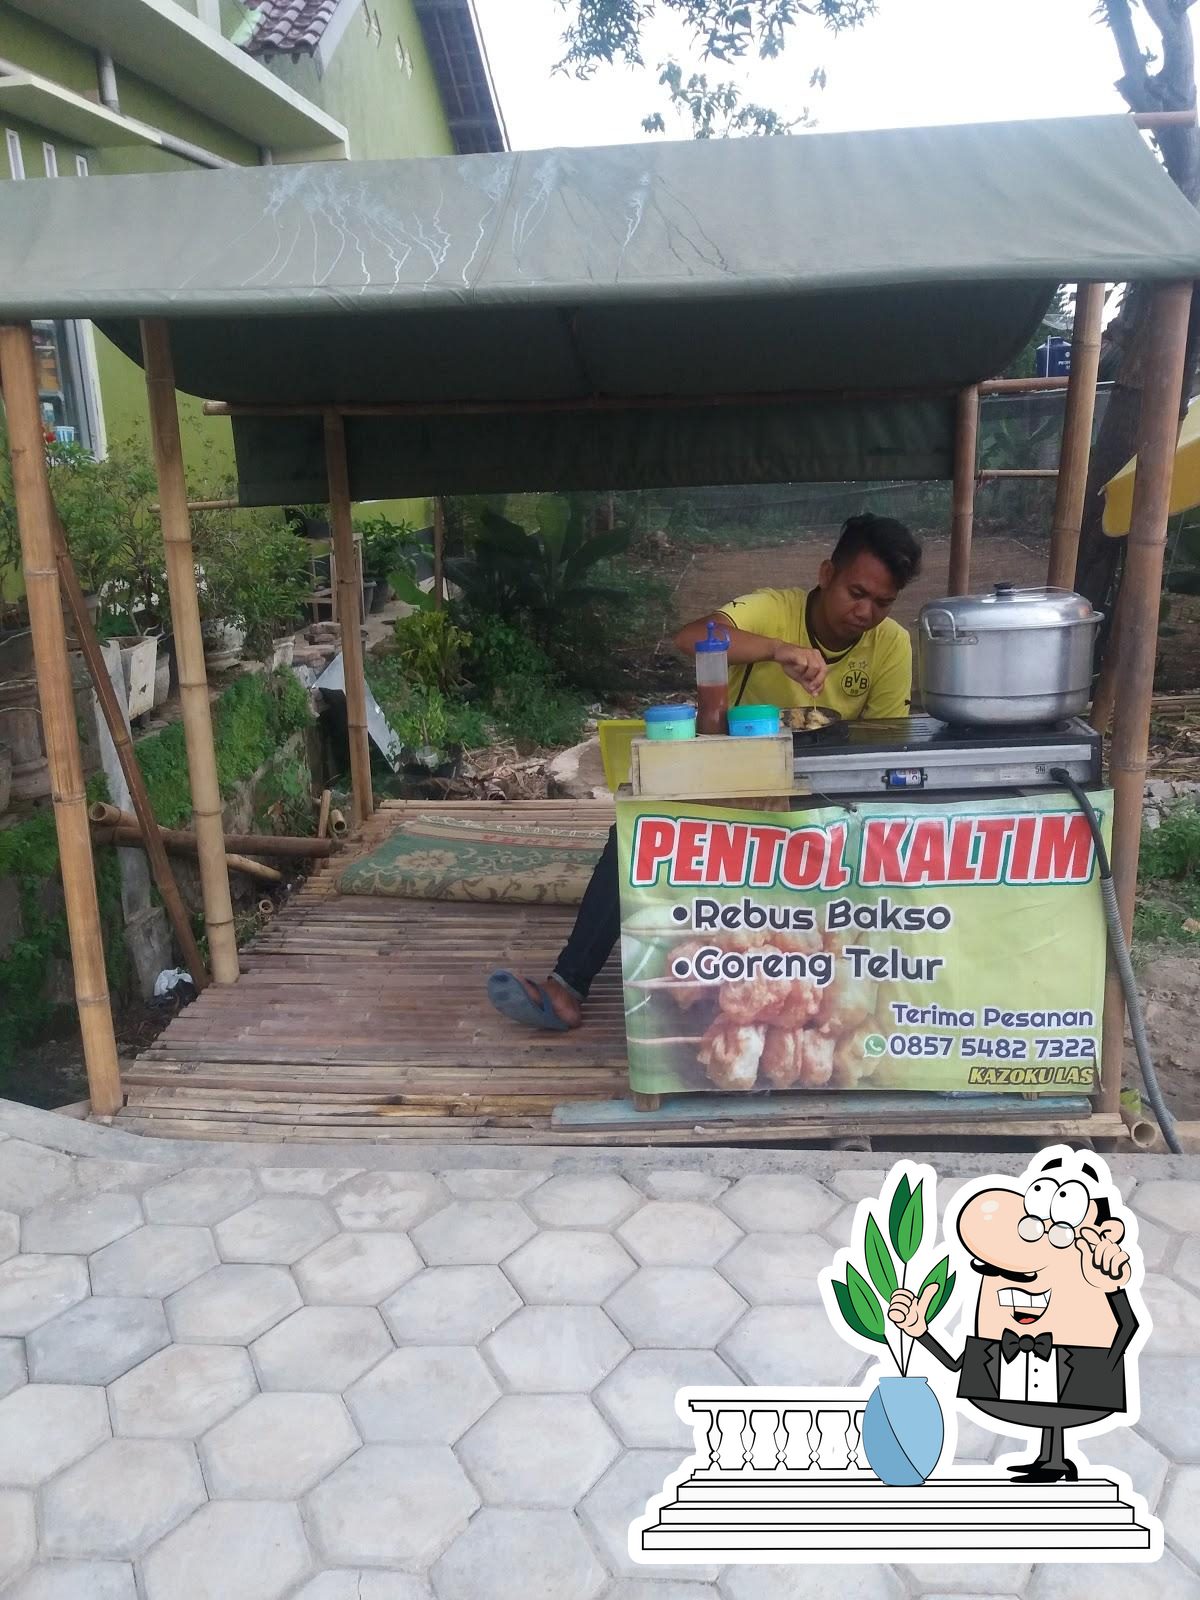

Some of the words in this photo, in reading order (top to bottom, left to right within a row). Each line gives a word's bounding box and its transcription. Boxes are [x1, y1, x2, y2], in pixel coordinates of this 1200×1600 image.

[845, 671, 868, 689] BVB
[632, 814, 851, 890] PENTOL
[859, 811, 1097, 885] KALTIM
[694, 899, 814, 930] Rebus
[827, 899, 951, 931] Bakso
[694, 948, 832, 985] Goreng
[845, 948, 943, 981] Telur
[892, 1003, 975, 1027] Terima
[983, 1007, 1094, 1028] Pesanan
[889, 1035, 953, 1056] 0857
[960, 1037, 1027, 1059] 5482
[1034, 1037, 1095, 1059] 7322
[968, 1066, 1054, 1085] KAZOKU
[1054, 1066, 1095, 1085] LAS
